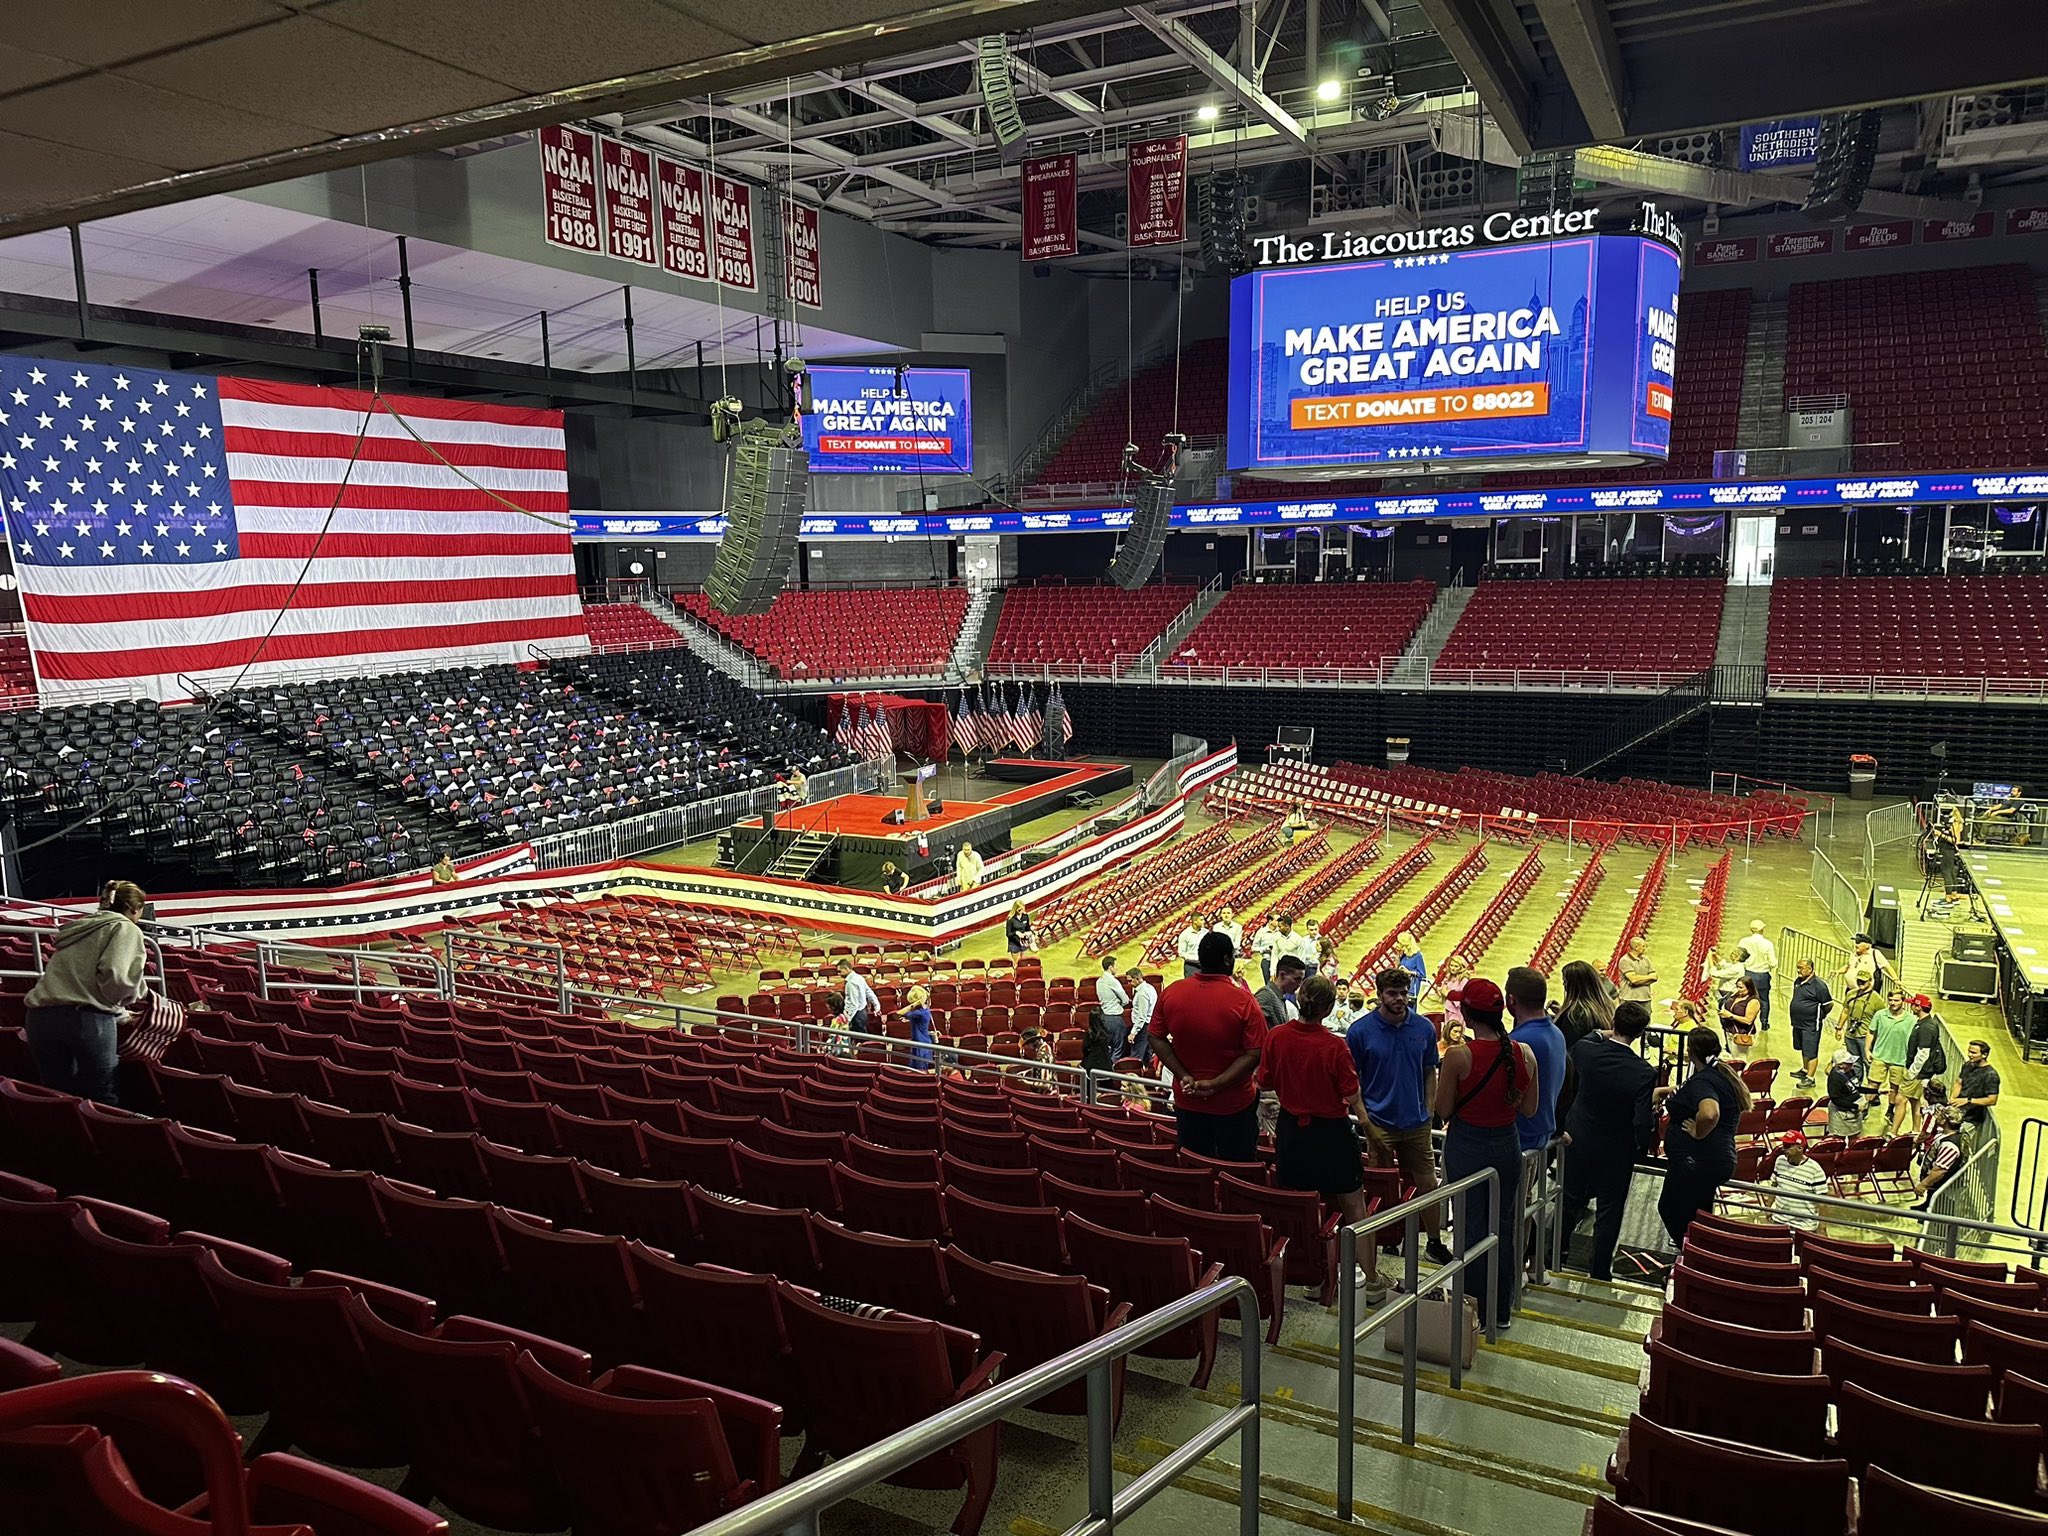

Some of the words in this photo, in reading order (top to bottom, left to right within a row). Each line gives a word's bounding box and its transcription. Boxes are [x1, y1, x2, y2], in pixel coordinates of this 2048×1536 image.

[1755, 128, 1815, 143] SOUTHERN
[1146, 144, 1166, 154] NCAA
[1752, 137, 1816, 152] METHODIST
[1132, 152, 1182, 166] TOURNAMENT
[1749, 146, 1818, 162] UNIVERSITY
[544, 144, 592, 185] NCAA
[1040, 161, 1058, 171] WNIT
[606, 162, 649, 200] NCAA
[1027, 170, 1070, 182] APPEARANCES
[552, 188, 591, 208] BASKETBALL
[662, 180, 702, 216] NCAA
[554, 202, 571, 216] ELITE
[572, 206, 591, 220] EIGHT
[613, 204, 648, 222] BASKETBALL
[712, 195, 748, 230] NCAA
[614, 216, 630, 230] ELITE
[632, 220, 647, 234] EIGHT
[1140, 220, 1173, 230] WOMEN'S
[1642, 201, 1664, 236] The
[550, 214, 596, 248] 1988
[668, 220, 700, 238] BASKETBALL
[1134, 230, 1179, 241] BASKETBALL
[1254, 234, 1314, 264] The
[1321, 224, 1474, 260] Liacouras
[1483, 208, 1600, 242] Center
[1870, 227, 1889, 236] Don
[1942, 225, 1976, 236] BLOOM
[612, 230, 652, 260] 1991
[670, 232, 684, 246] ELITE
[685, 236, 700, 249] EIGHT
[1034, 234, 1066, 244] WOMEN'S
[1783, 235, 1819, 245] Terence
[732, 248, 747, 260] EIGHT
[1028, 243, 1070, 256] BASKETBALL
[1706, 249, 1744, 259] SANCHEZ
[1716, 243, 1737, 252] Pepe
[1774, 241, 1826, 253] STANSBURY
[667, 244, 705, 274] 1993
[718, 257, 751, 284] 1999
[1375, 296, 1430, 317] HELP
[1436, 292, 1466, 311] US
[1285, 322, 1384, 356] MAKE
[1392, 307, 1560, 348] AMERICA
[1648, 306, 1674, 344] MAKE
[1300, 351, 1416, 385] GREAT
[1424, 341, 1540, 378] AGAIN
[861, 388, 890, 398] HELP
[813, 399, 868, 414] MAKE
[871, 400, 955, 416] AMERICA
[1304, 404, 1350, 422] TEXT
[1356, 397, 1436, 418] DONATE
[1442, 395, 1468, 412] TO
[1472, 391, 1534, 410] 88022
[823, 415, 884, 431] GREAT
[889, 416, 946, 432] AGAIN
[826, 440, 852, 449] TEXT
[854, 440, 896, 450] DONATE
[898, 441, 912, 449] TO
[1836, 482, 1867, 491] MAKE
[1869, 480, 1919, 490] AMERICA
[1972, 478, 2006, 487] MAKE
[1591, 491, 1618, 499] MAKE
[1619, 489, 1663, 498] AMERICA
[1709, 487, 1738, 496] MAKE
[1740, 485, 1786, 494] AMERICA
[1841, 490, 1877, 499] GREAT
[1878, 488, 1913, 498] AGAIN
[1977, 486, 2016, 494] GREAT
[1400, 498, 1439, 507] AMERICA
[1479, 496, 1505, 504] MAKE
[1506, 494, 1548, 502] AMERICA
[1301, 503, 1338, 511] AMERICA
